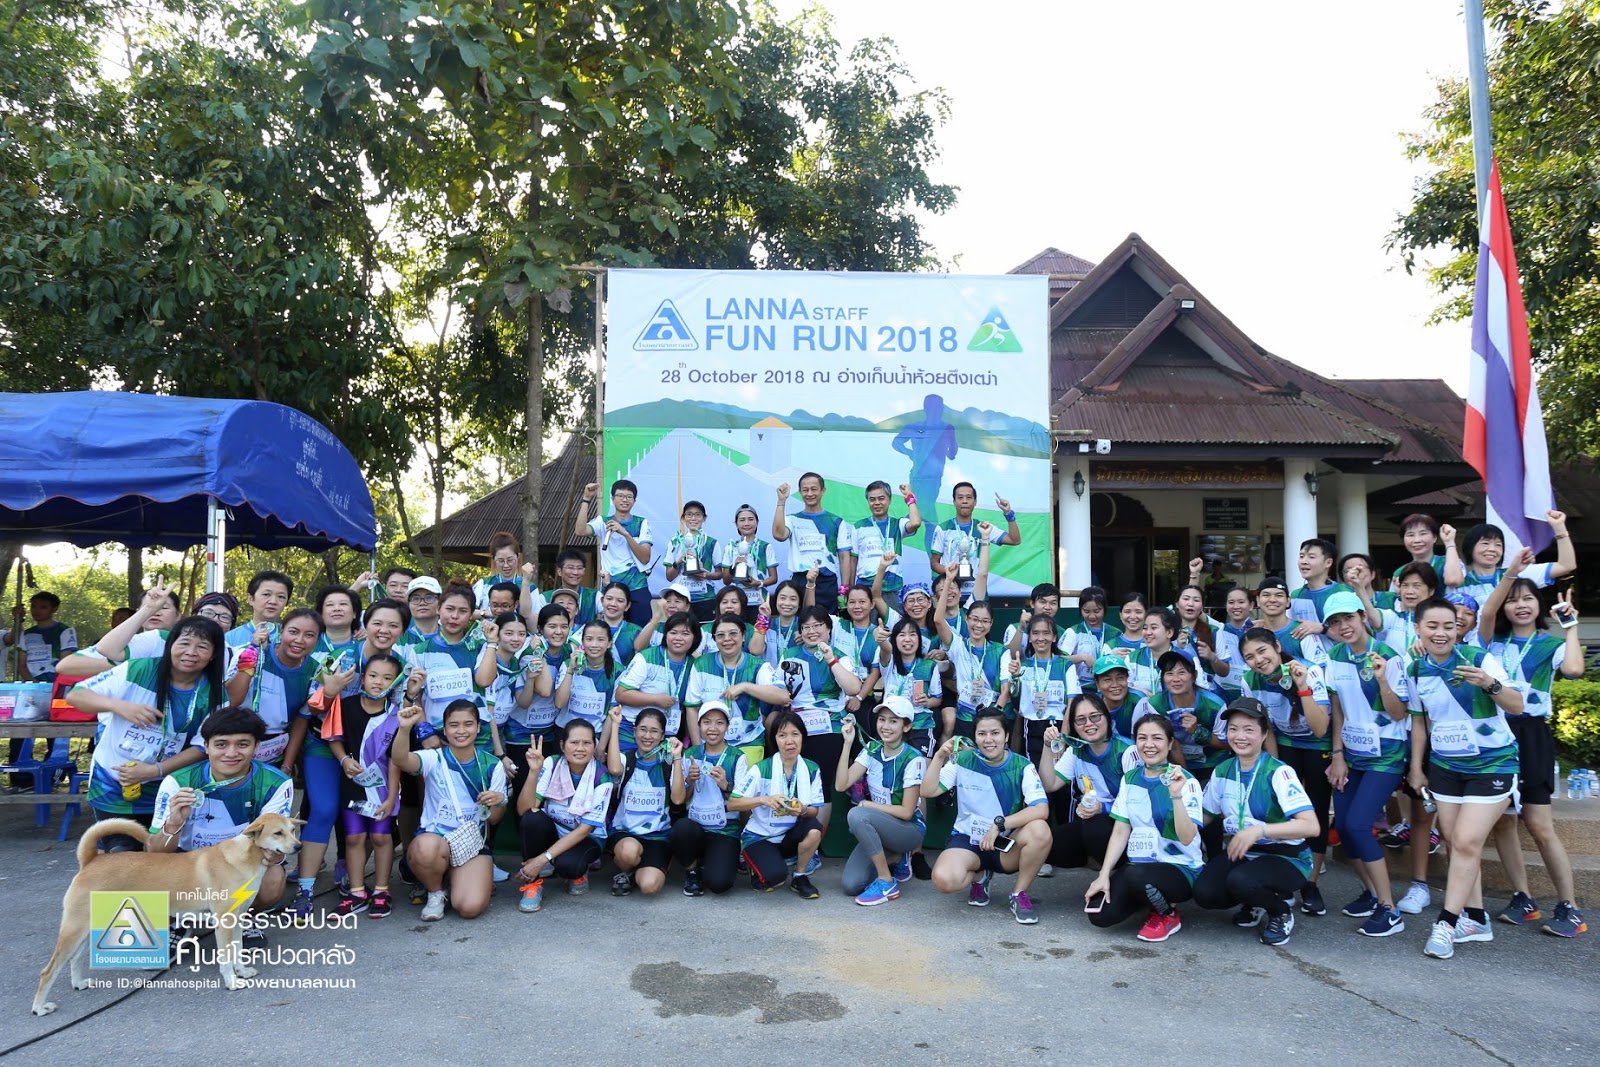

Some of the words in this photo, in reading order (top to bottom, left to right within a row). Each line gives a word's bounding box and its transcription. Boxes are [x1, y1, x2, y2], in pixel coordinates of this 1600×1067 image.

[705, 297, 810, 321] LANNA
[811, 306, 870, 322] STAFF
[705, 324, 777, 352] FUN
[792, 324, 869, 352] RUN
[876, 325, 959, 353] 2018
[688, 368, 758, 385] October
[764, 369, 806, 385] 2018
[812, 370, 831, 384] ณ
